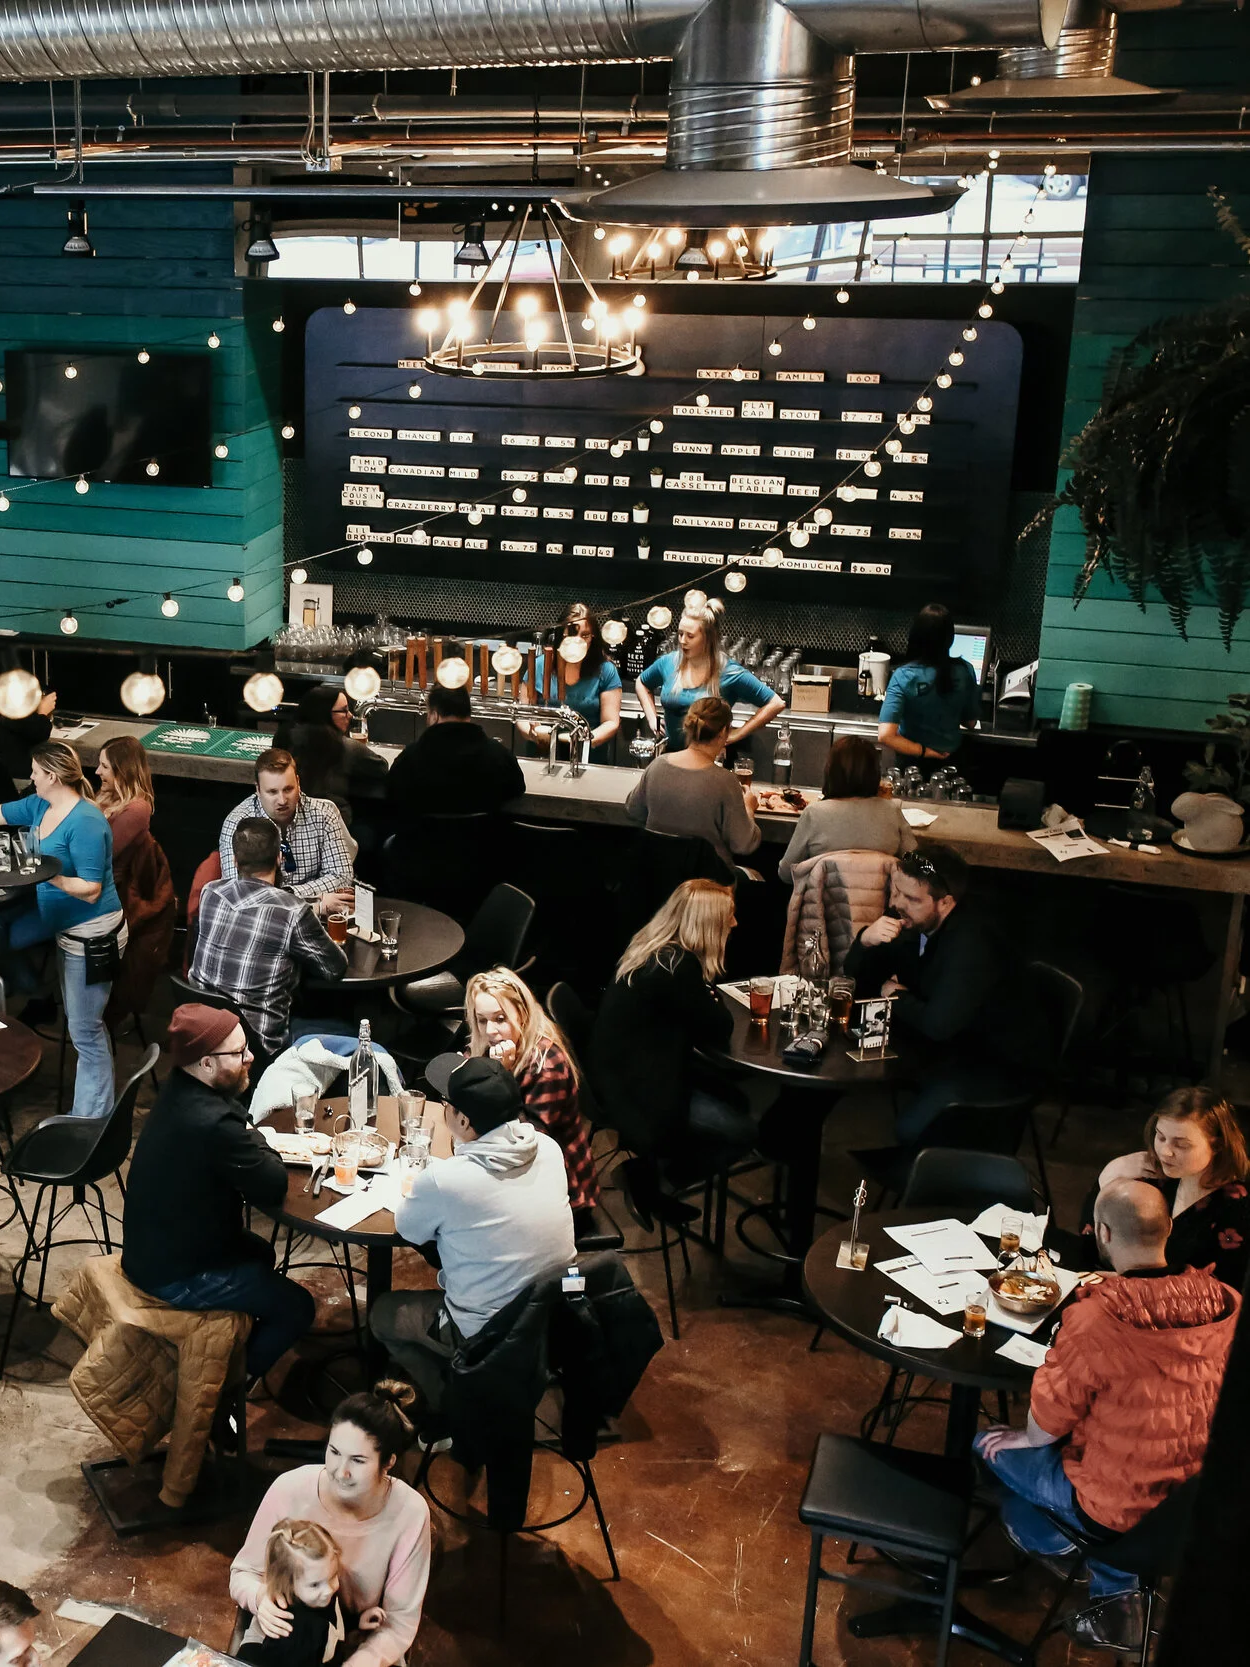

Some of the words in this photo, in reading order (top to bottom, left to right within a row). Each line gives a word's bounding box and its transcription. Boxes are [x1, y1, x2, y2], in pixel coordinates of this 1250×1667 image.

[777, 373, 823, 381] FAMILY
[675, 407, 733, 415] TOOLSHED
[742, 409, 764, 417] CAP
[781, 411, 818, 419] STOUT
[843, 412, 881, 421] $7.75
[350, 430, 389, 438] SECOND
[503, 436, 537, 445] $6.75
[546, 439, 574, 447] 6.5%
[673, 445, 710, 453] SUNNY
[722, 446, 758, 455] APPLE
[774, 448, 813, 457] CIDER
[351, 458, 384, 466] TIMID
[390, 467, 442, 476] CANADIAN
[450, 470, 477, 478] MILD
[502, 472, 536, 480] $6.75
[666, 481, 724, 490] CASSETTE
[731, 477, 783, 486] BELGIAN
[345, 485, 377, 493] TARTY
[739, 485, 774, 493] TABLE
[789, 488, 818, 496] BEER
[342, 491, 382, 500] COUSIN
[387, 501, 453, 511] CRAZZBERRY
[502, 508, 535, 516] $6.75
[545, 510, 572, 518] 3.5%
[613, 514, 626, 522] 25
[674, 517, 732, 528] RAILYARD
[740, 521, 776, 530] PEACH
[832, 527, 869, 536] $7.75
[890, 531, 921, 540] 5.2%
[465, 541, 485, 549] ALE
[502, 543, 535, 551] $6.75
[779, 560, 840, 572] KOMBUCHA
[852, 565, 890, 574] $6.00
